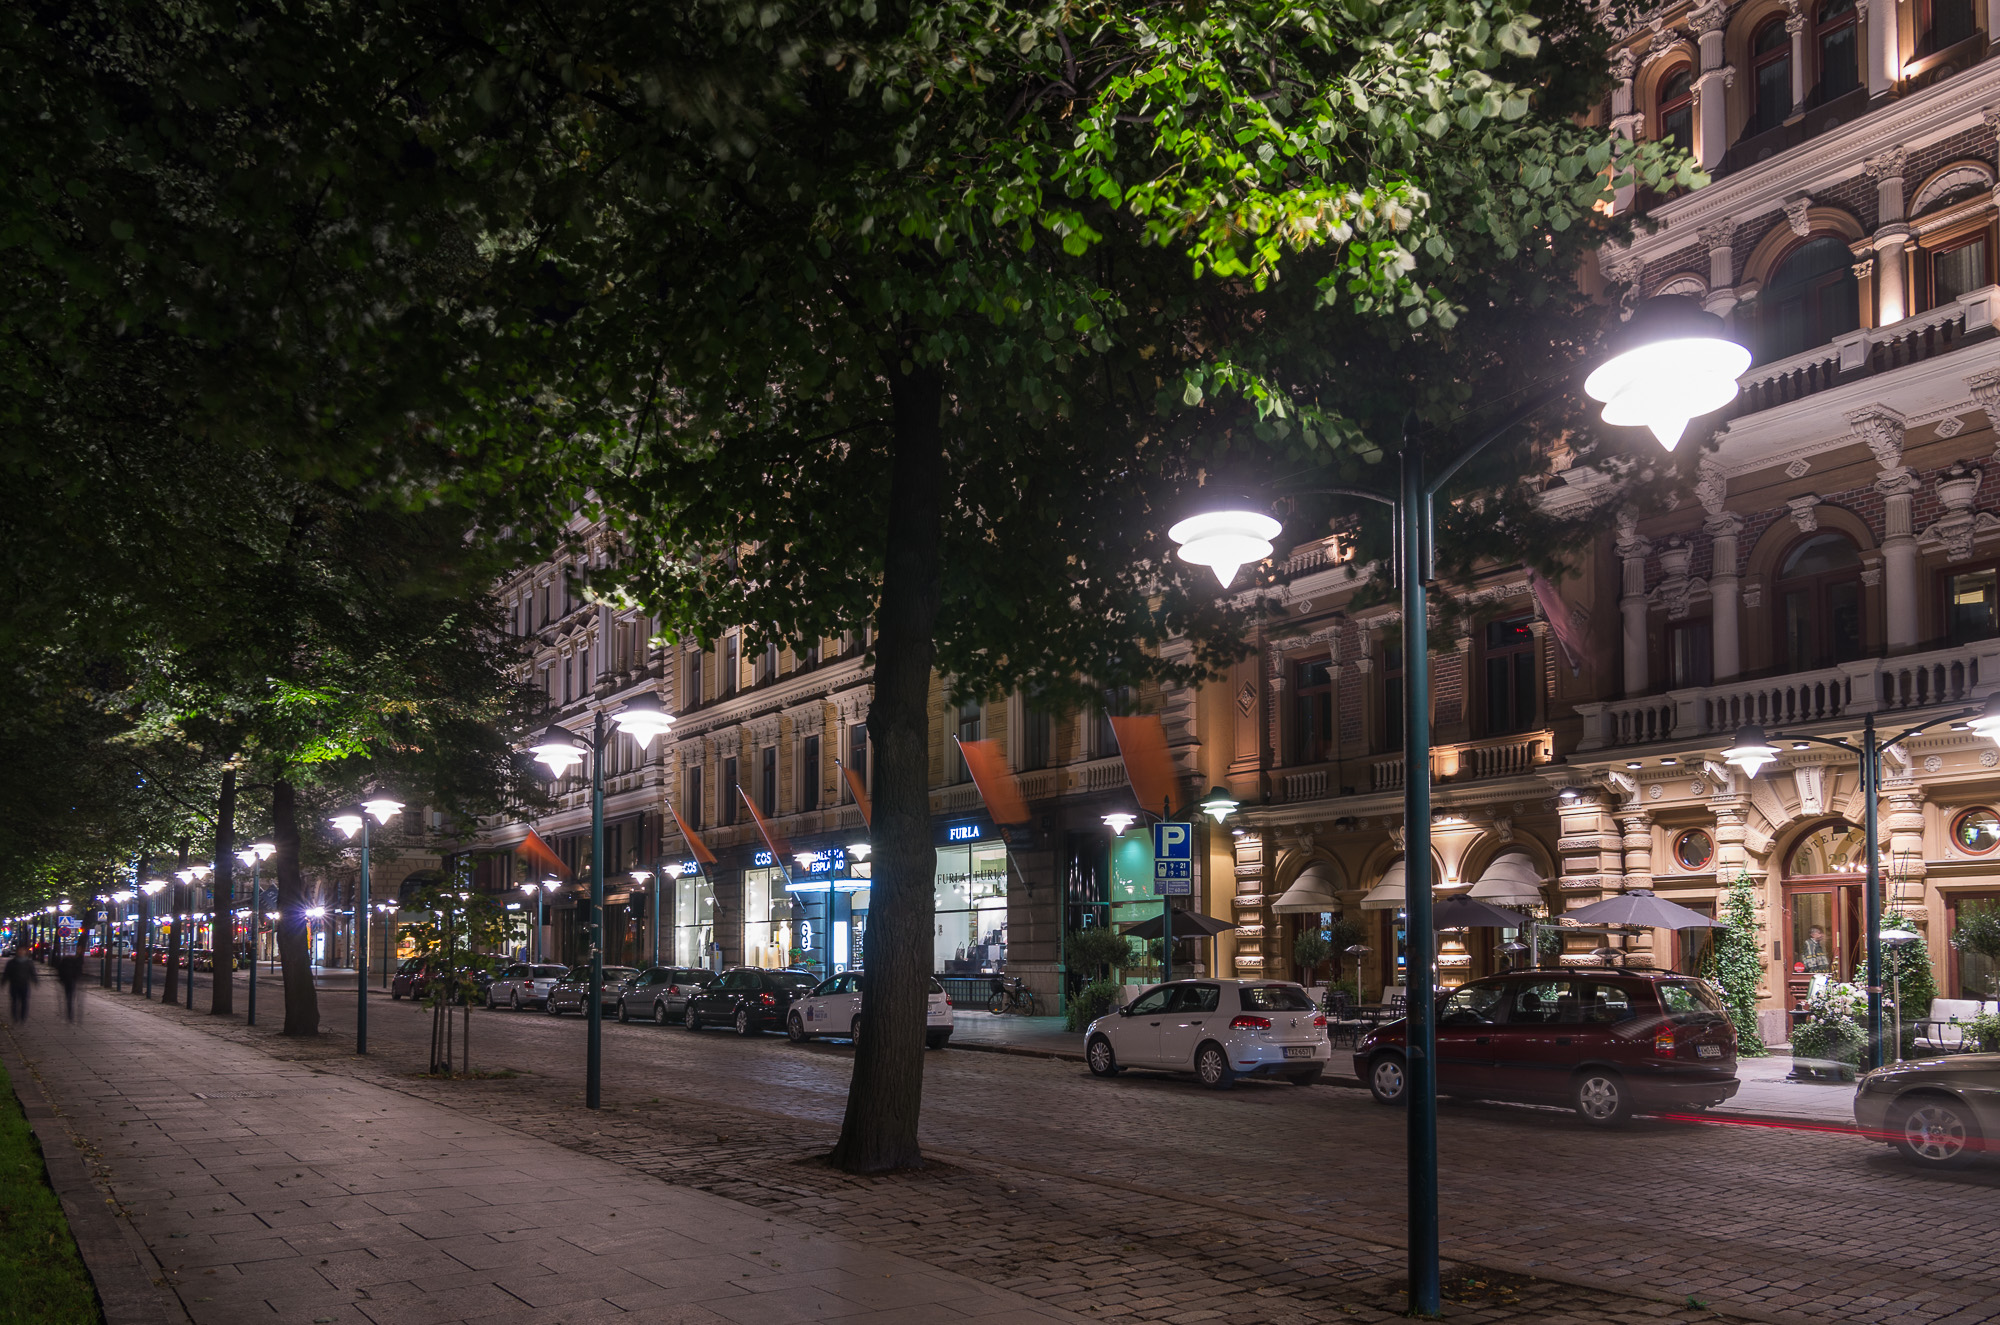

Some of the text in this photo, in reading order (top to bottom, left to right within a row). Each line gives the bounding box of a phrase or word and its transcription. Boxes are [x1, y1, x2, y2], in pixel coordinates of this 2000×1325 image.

[950, 825, 979, 840] FURLA
[1163, 826, 1185, 856] P
[755, 851, 772, 866] COS
[1828, 852, 1848, 866] 29
[683, 861, 697, 874] COS
